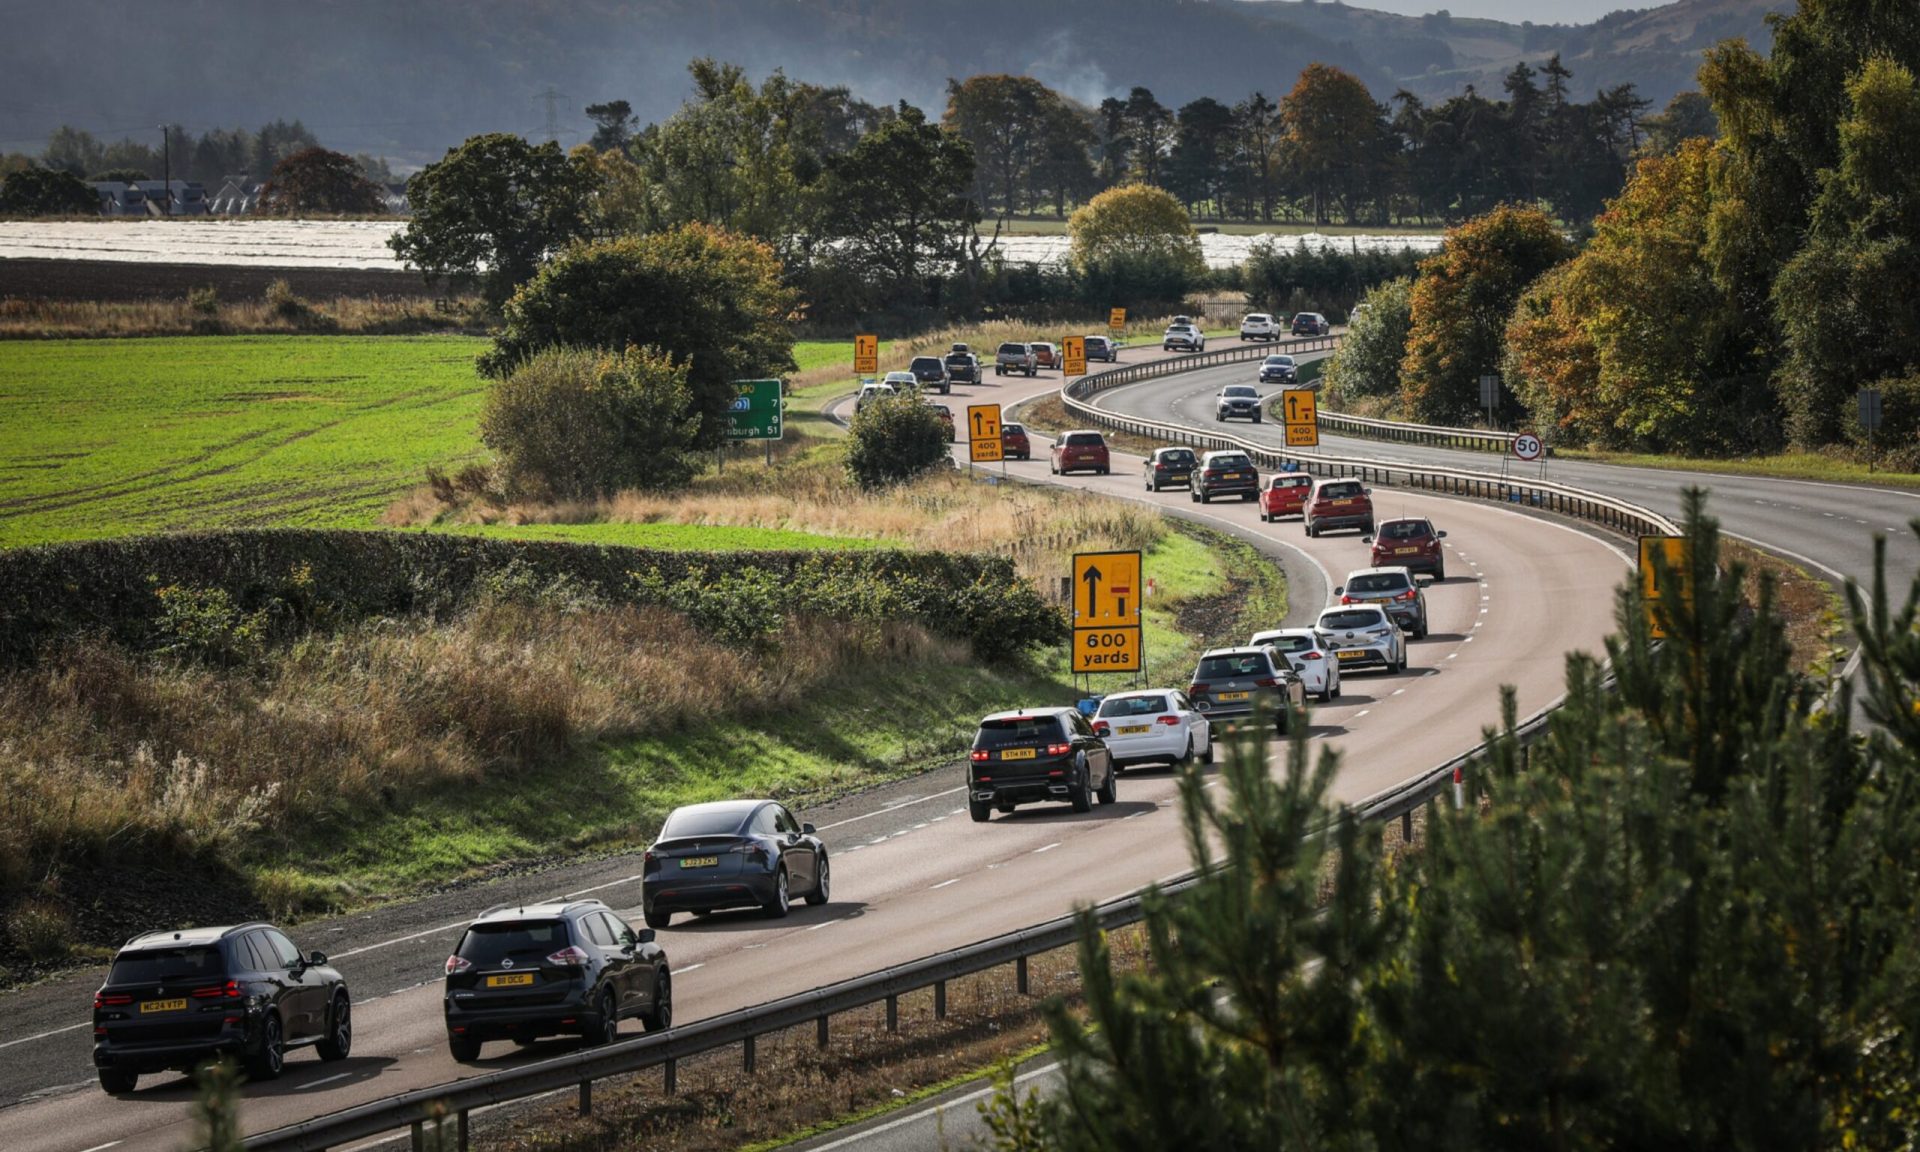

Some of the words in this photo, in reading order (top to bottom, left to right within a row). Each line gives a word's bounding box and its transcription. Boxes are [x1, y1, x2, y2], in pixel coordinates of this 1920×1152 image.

[771, 399, 778, 408] 7
[771, 415, 779, 424] 9
[767, 426, 778, 435] 51
[1291, 435, 1313, 443] yards
[1518, 439, 1538, 452] 50
[976, 450, 998, 458] yards
[1087, 633, 1126, 648] 600
[1084, 651, 1129, 666] yards
[167, 999, 184, 1009] VTP
